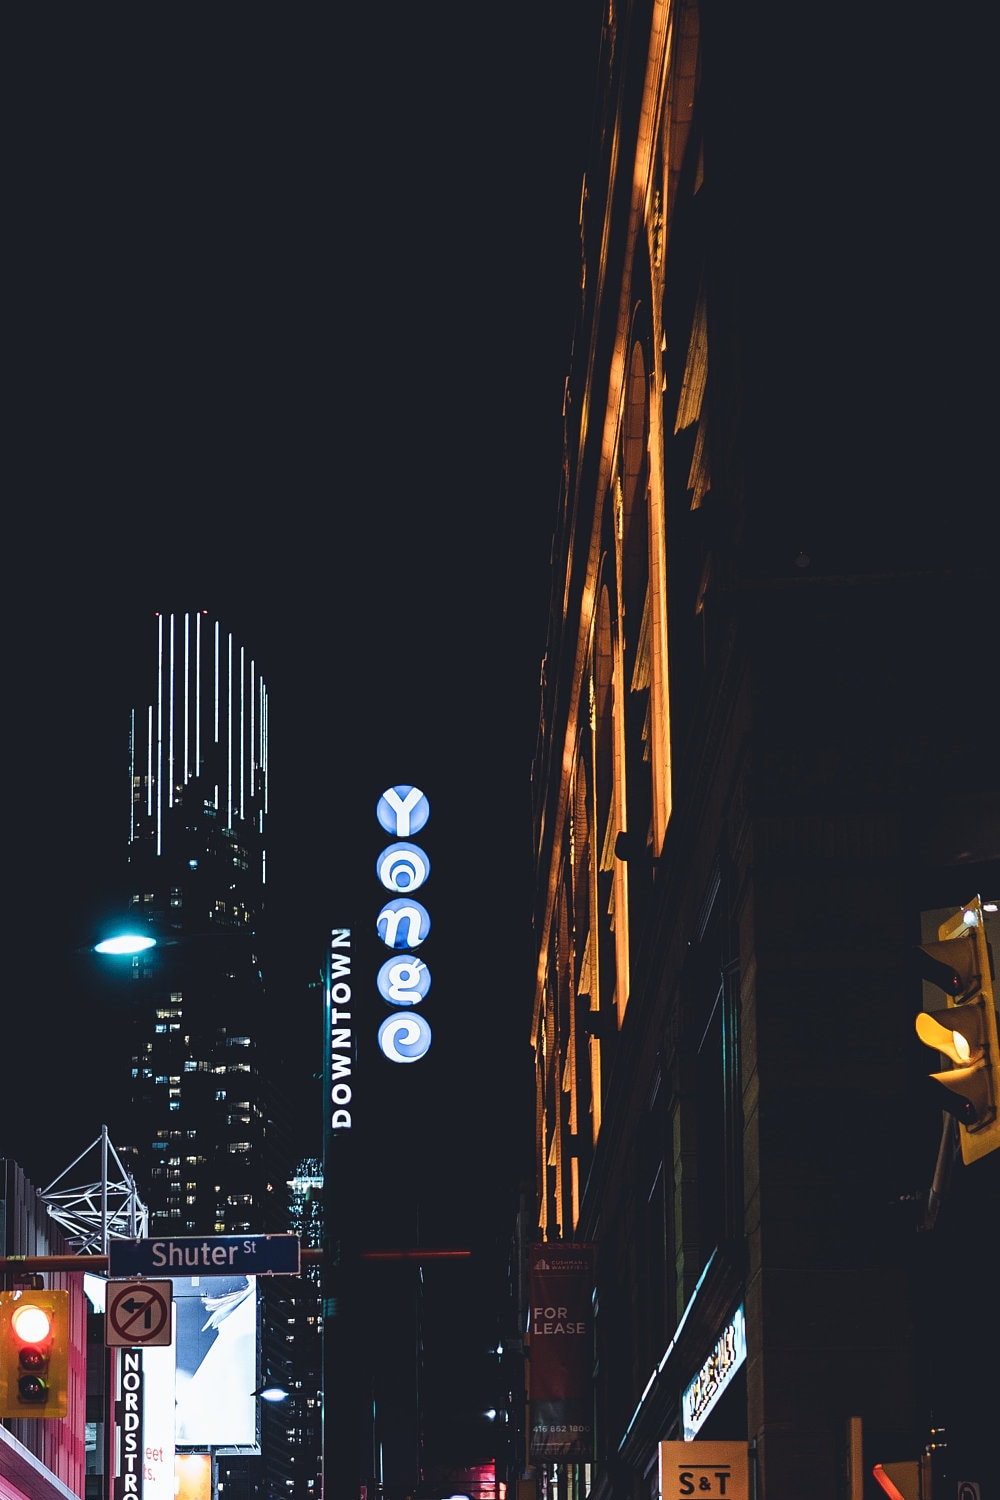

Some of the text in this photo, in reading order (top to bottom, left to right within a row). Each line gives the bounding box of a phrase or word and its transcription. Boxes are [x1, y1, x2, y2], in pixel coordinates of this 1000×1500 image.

[376, 784, 431, 1063] Yonge
[331, 928, 352, 1128] DOWNTOWN
[152, 1240, 257, 1267] Shuter St
[533, 1307, 568, 1320] FOR
[533, 1322, 586, 1335] LEASE
[532, 1425, 548, 1433] 416
[145, 1447, 164, 1462] eet
